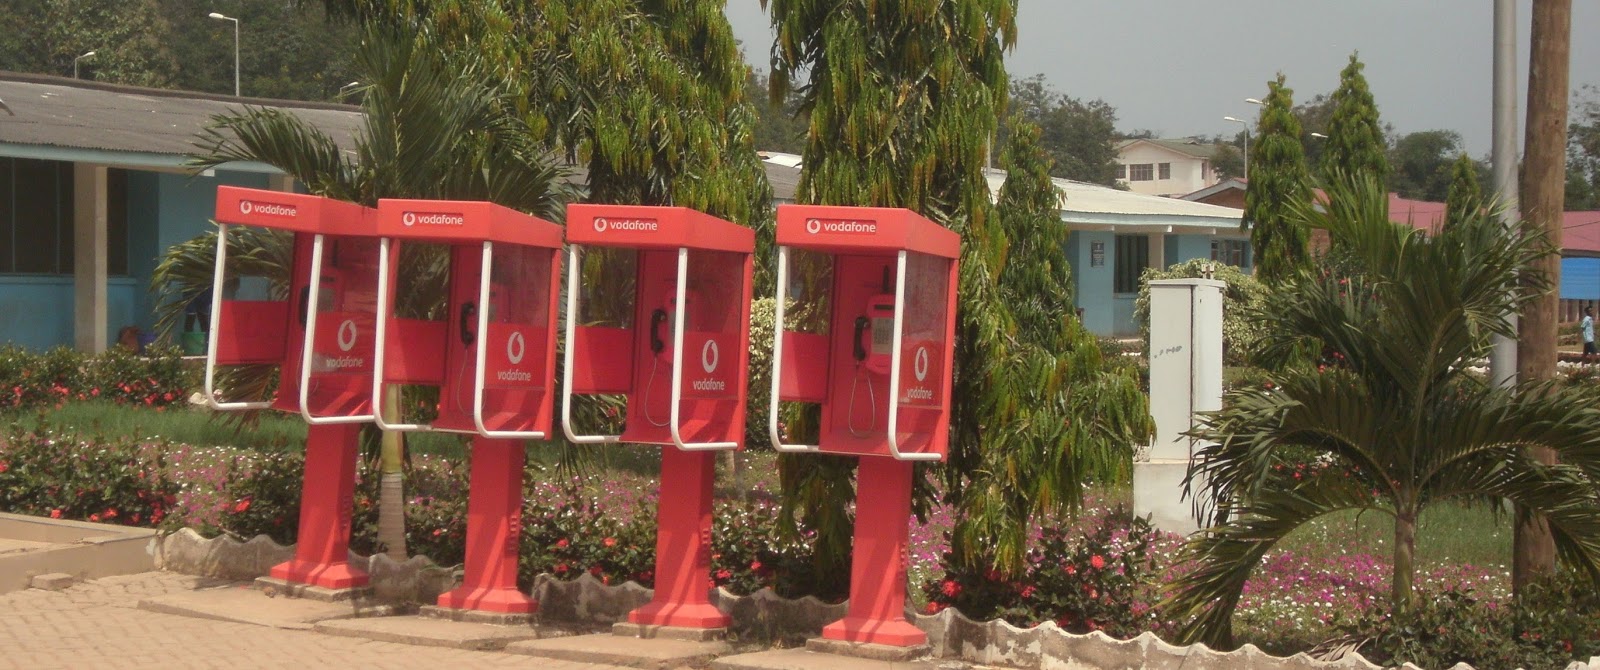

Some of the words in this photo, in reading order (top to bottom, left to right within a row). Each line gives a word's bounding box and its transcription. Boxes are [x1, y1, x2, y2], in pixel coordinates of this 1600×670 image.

[254, 204, 296, 216] vodafone
[418, 214, 463, 225] vodafone
[609, 219, 657, 231] vodafone
[824, 221, 876, 232] vodafone
[326, 356, 363, 368] vodafone
[498, 369, 531, 381] vodafone
[693, 378, 725, 390] vodafone
[907, 387, 932, 399] vodafone
